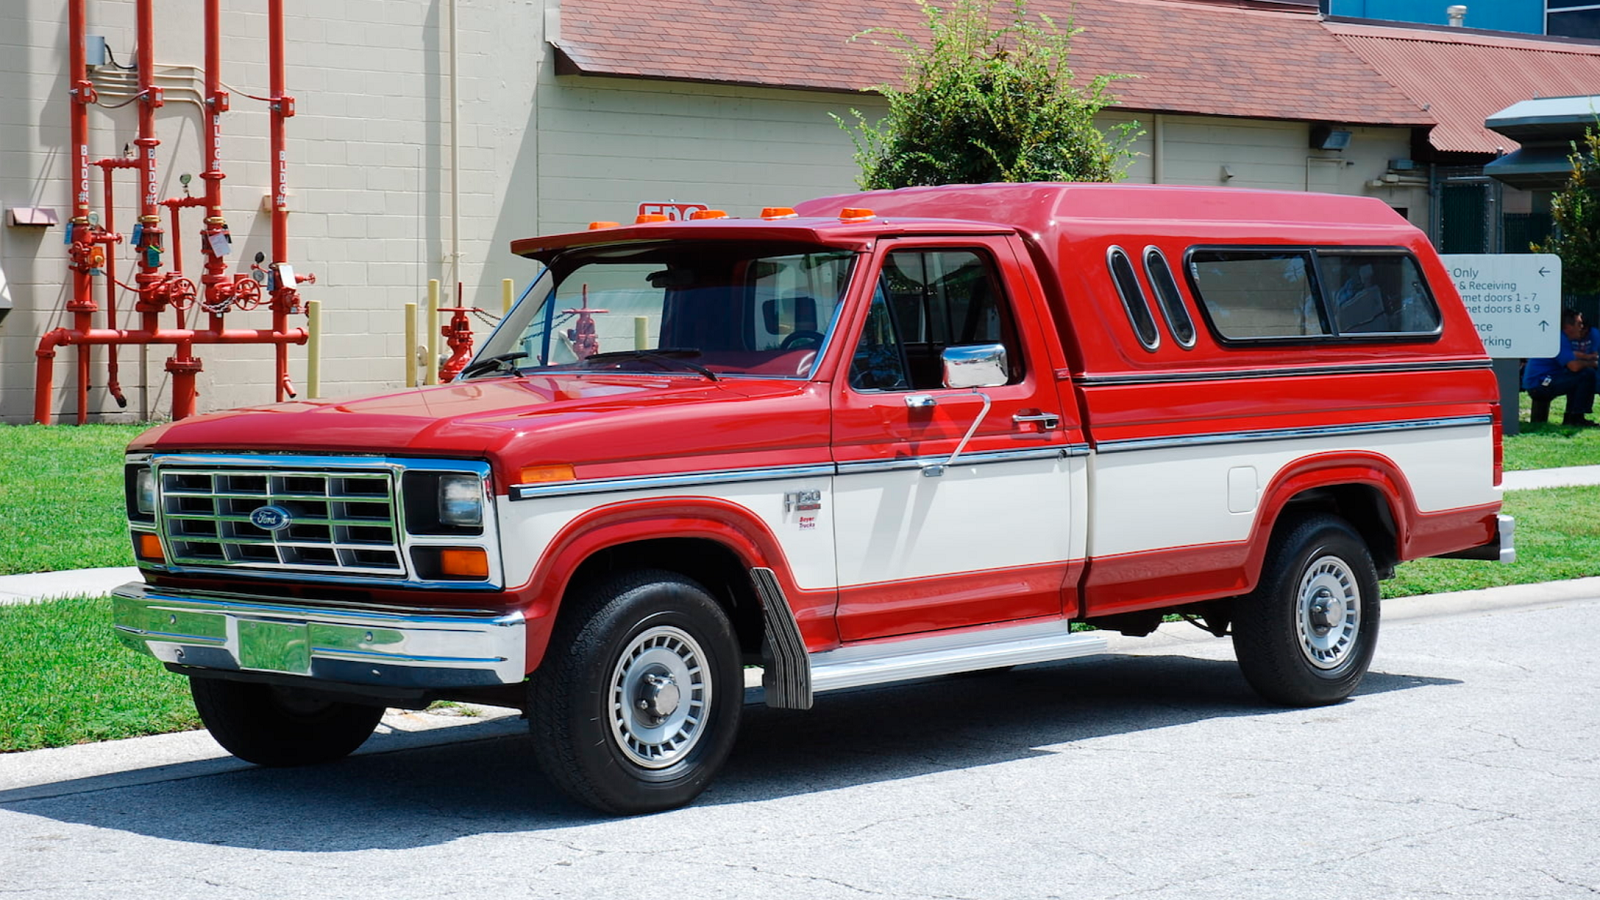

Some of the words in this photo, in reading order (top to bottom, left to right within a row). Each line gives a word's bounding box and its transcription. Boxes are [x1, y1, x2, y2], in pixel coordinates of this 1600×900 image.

[1453, 267, 1479, 280] Only
[1459, 281, 1466, 290] &
[1469, 280, 1517, 292] Receiving
[1484, 293, 1513, 302] doors
[1516, 293, 1521, 301] 1
[1531, 293, 1537, 301] 7
[1484, 304, 1513, 313] doors
[1515, 304, 1521, 313] 8
[1524, 304, 1531, 313] &
[1534, 304, 1540, 313] 9
[257, 510, 277, 524] Ford
